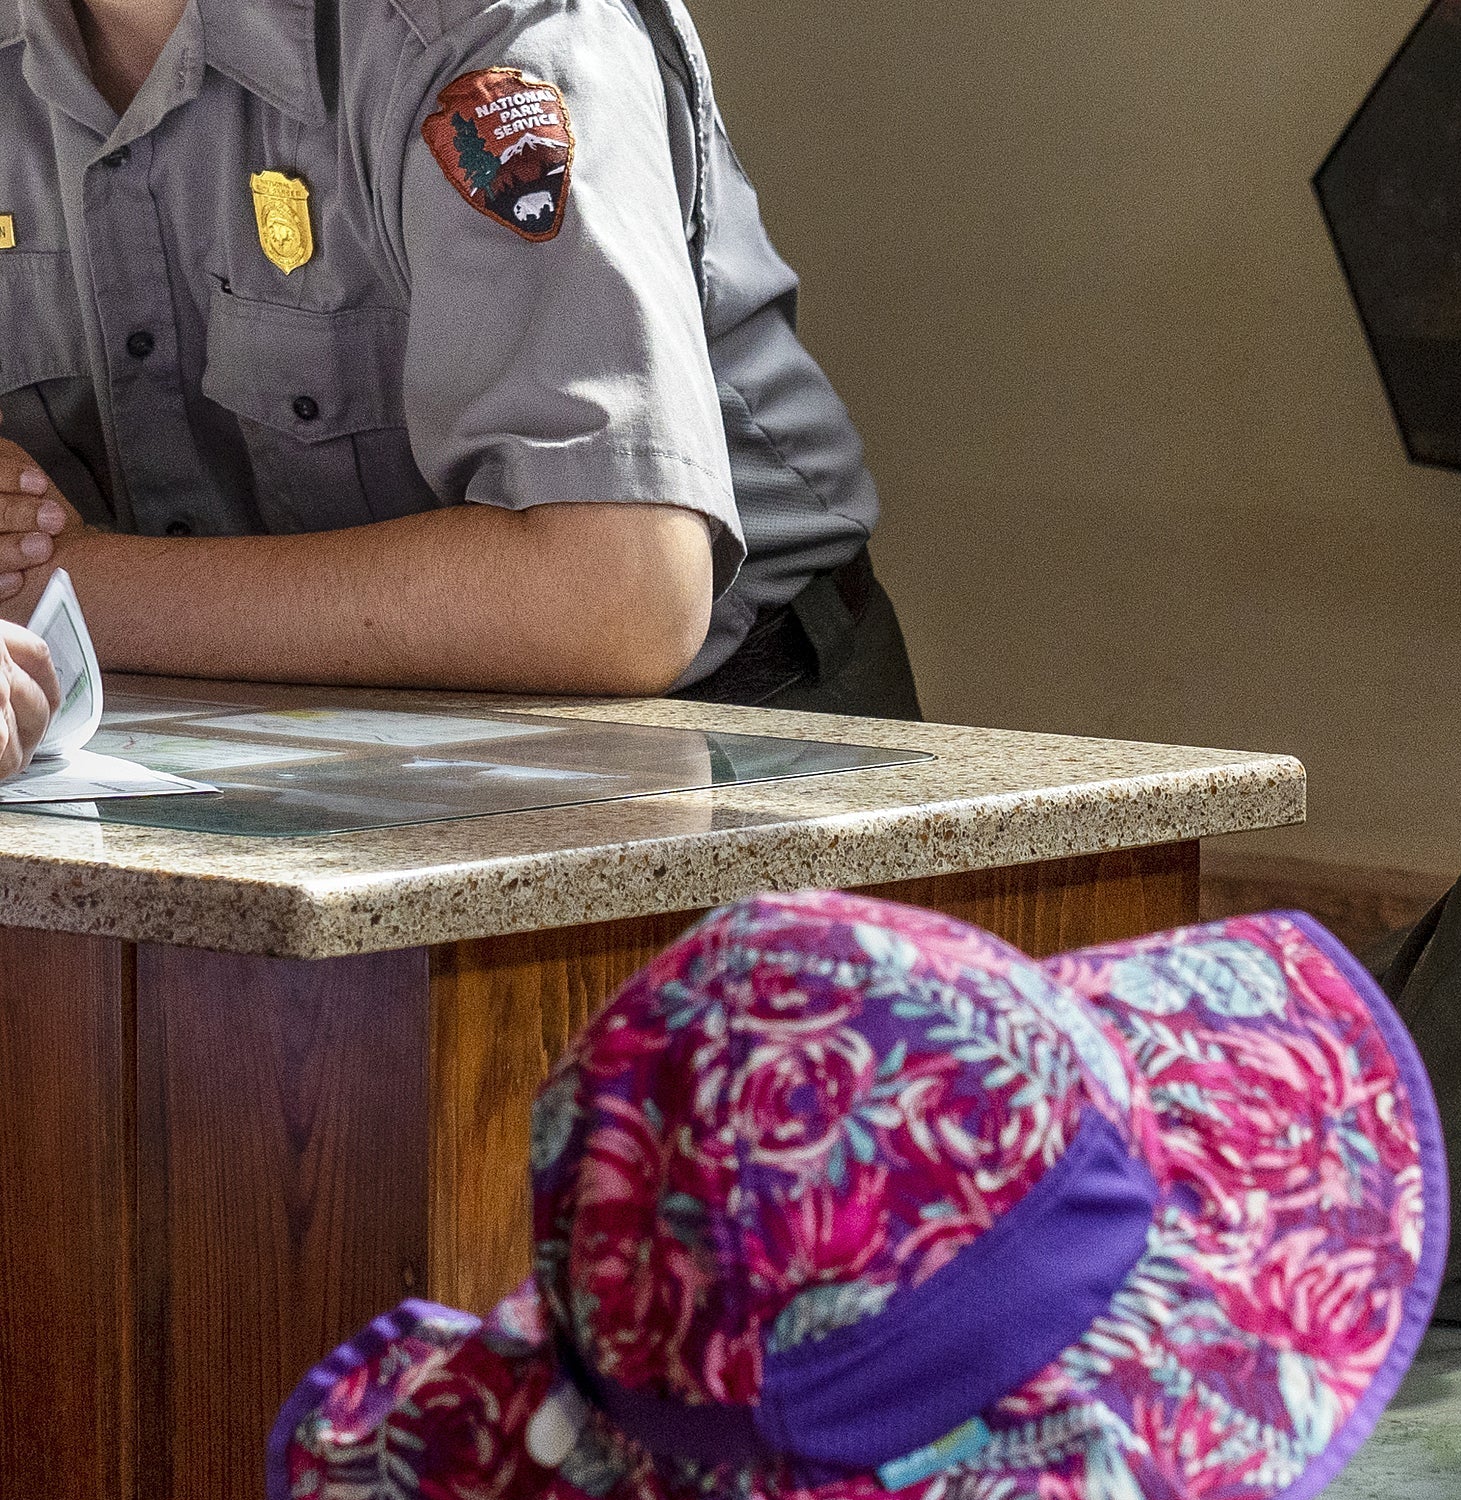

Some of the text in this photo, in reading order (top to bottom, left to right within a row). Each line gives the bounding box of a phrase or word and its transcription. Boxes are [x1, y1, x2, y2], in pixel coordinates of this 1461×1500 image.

[475, 89, 557, 118] NATIONAL
[500, 102, 543, 123] PARK
[493, 113, 559, 140] SERVICE
